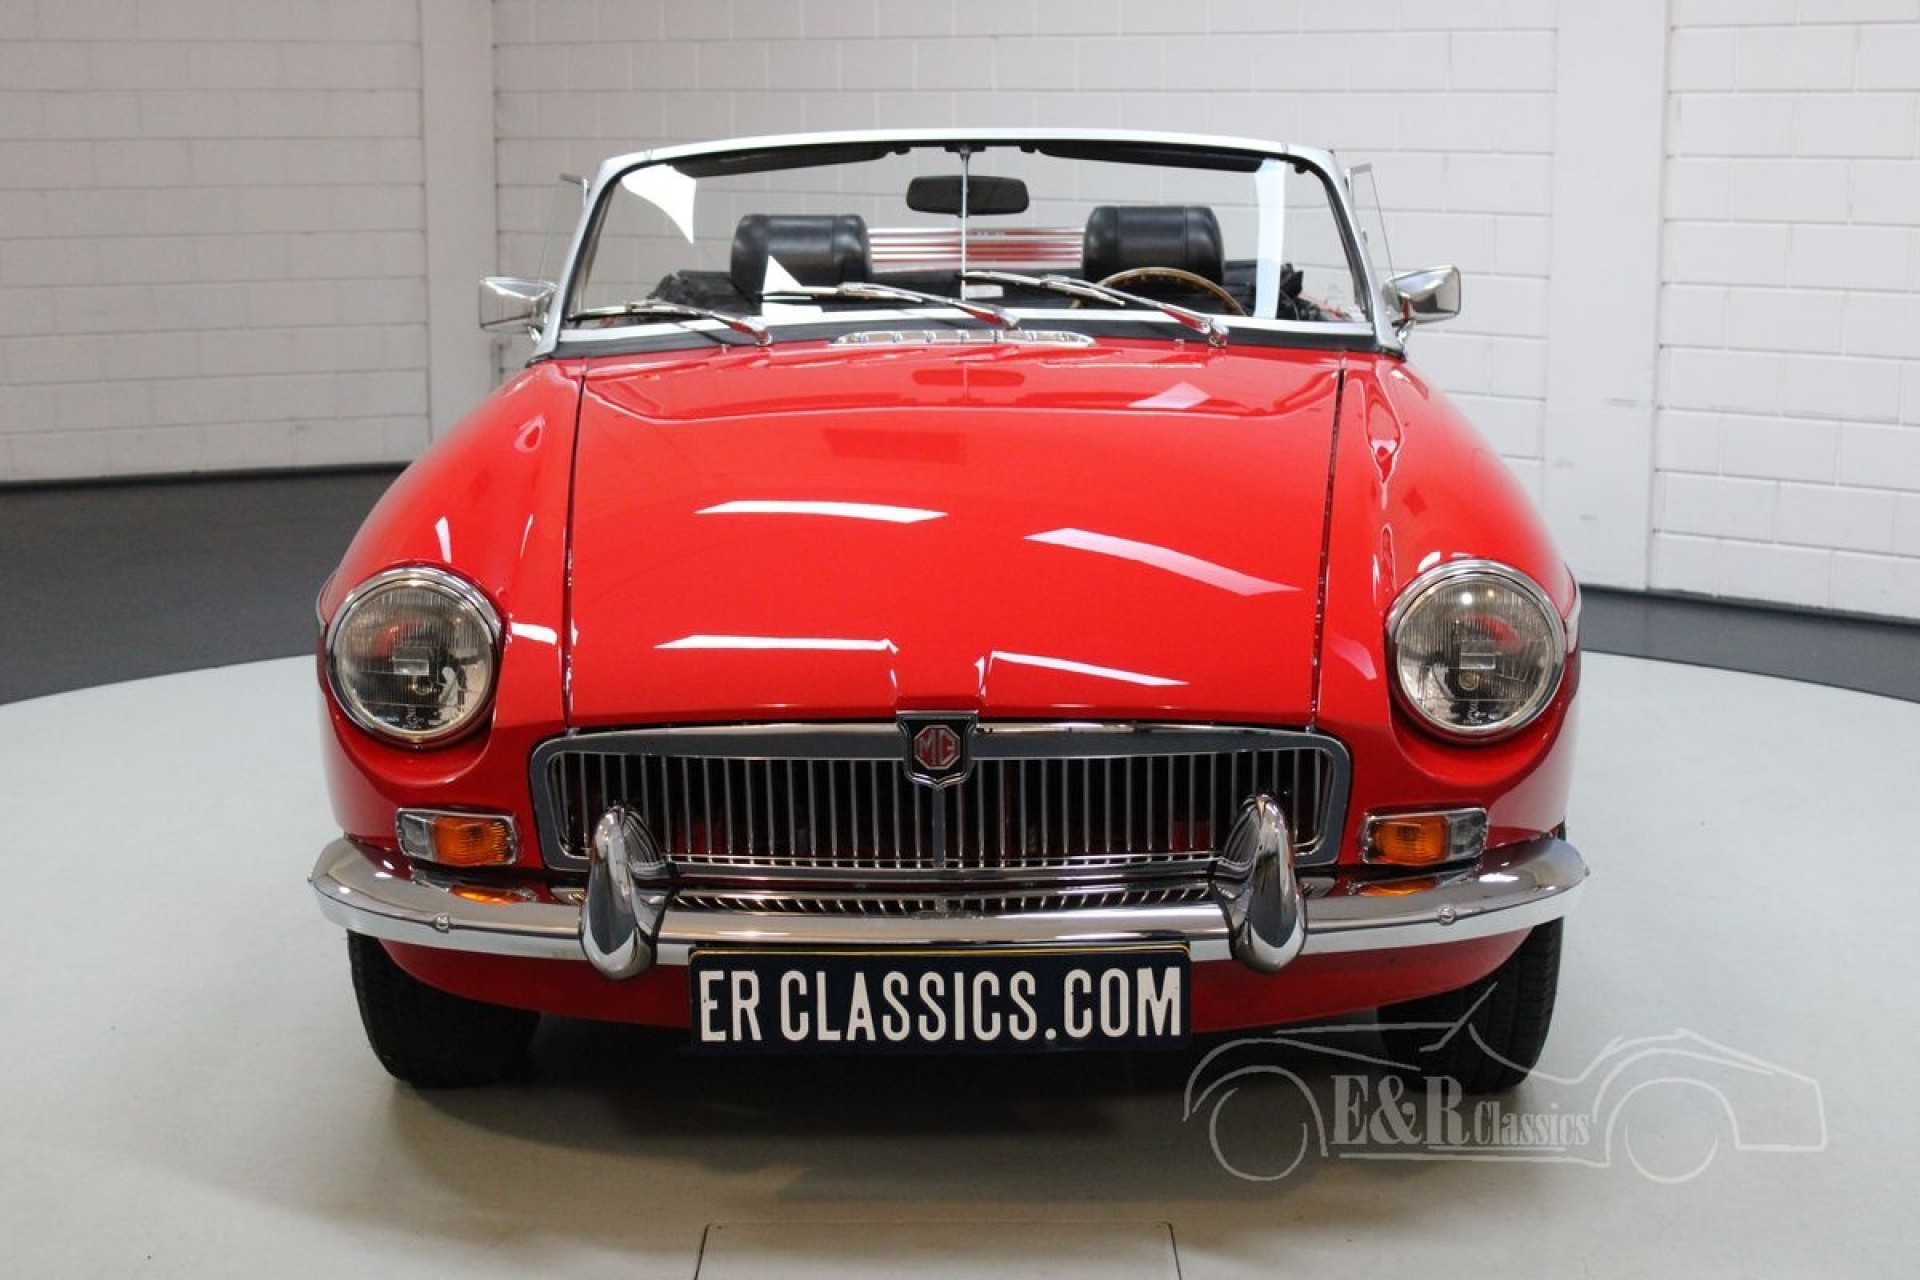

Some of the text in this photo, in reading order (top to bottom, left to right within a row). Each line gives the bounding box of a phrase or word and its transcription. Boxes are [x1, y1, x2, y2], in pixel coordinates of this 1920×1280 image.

[918, 728, 956, 766] MG
[699, 967, 1182, 1042] ER CLASSICS.COM
